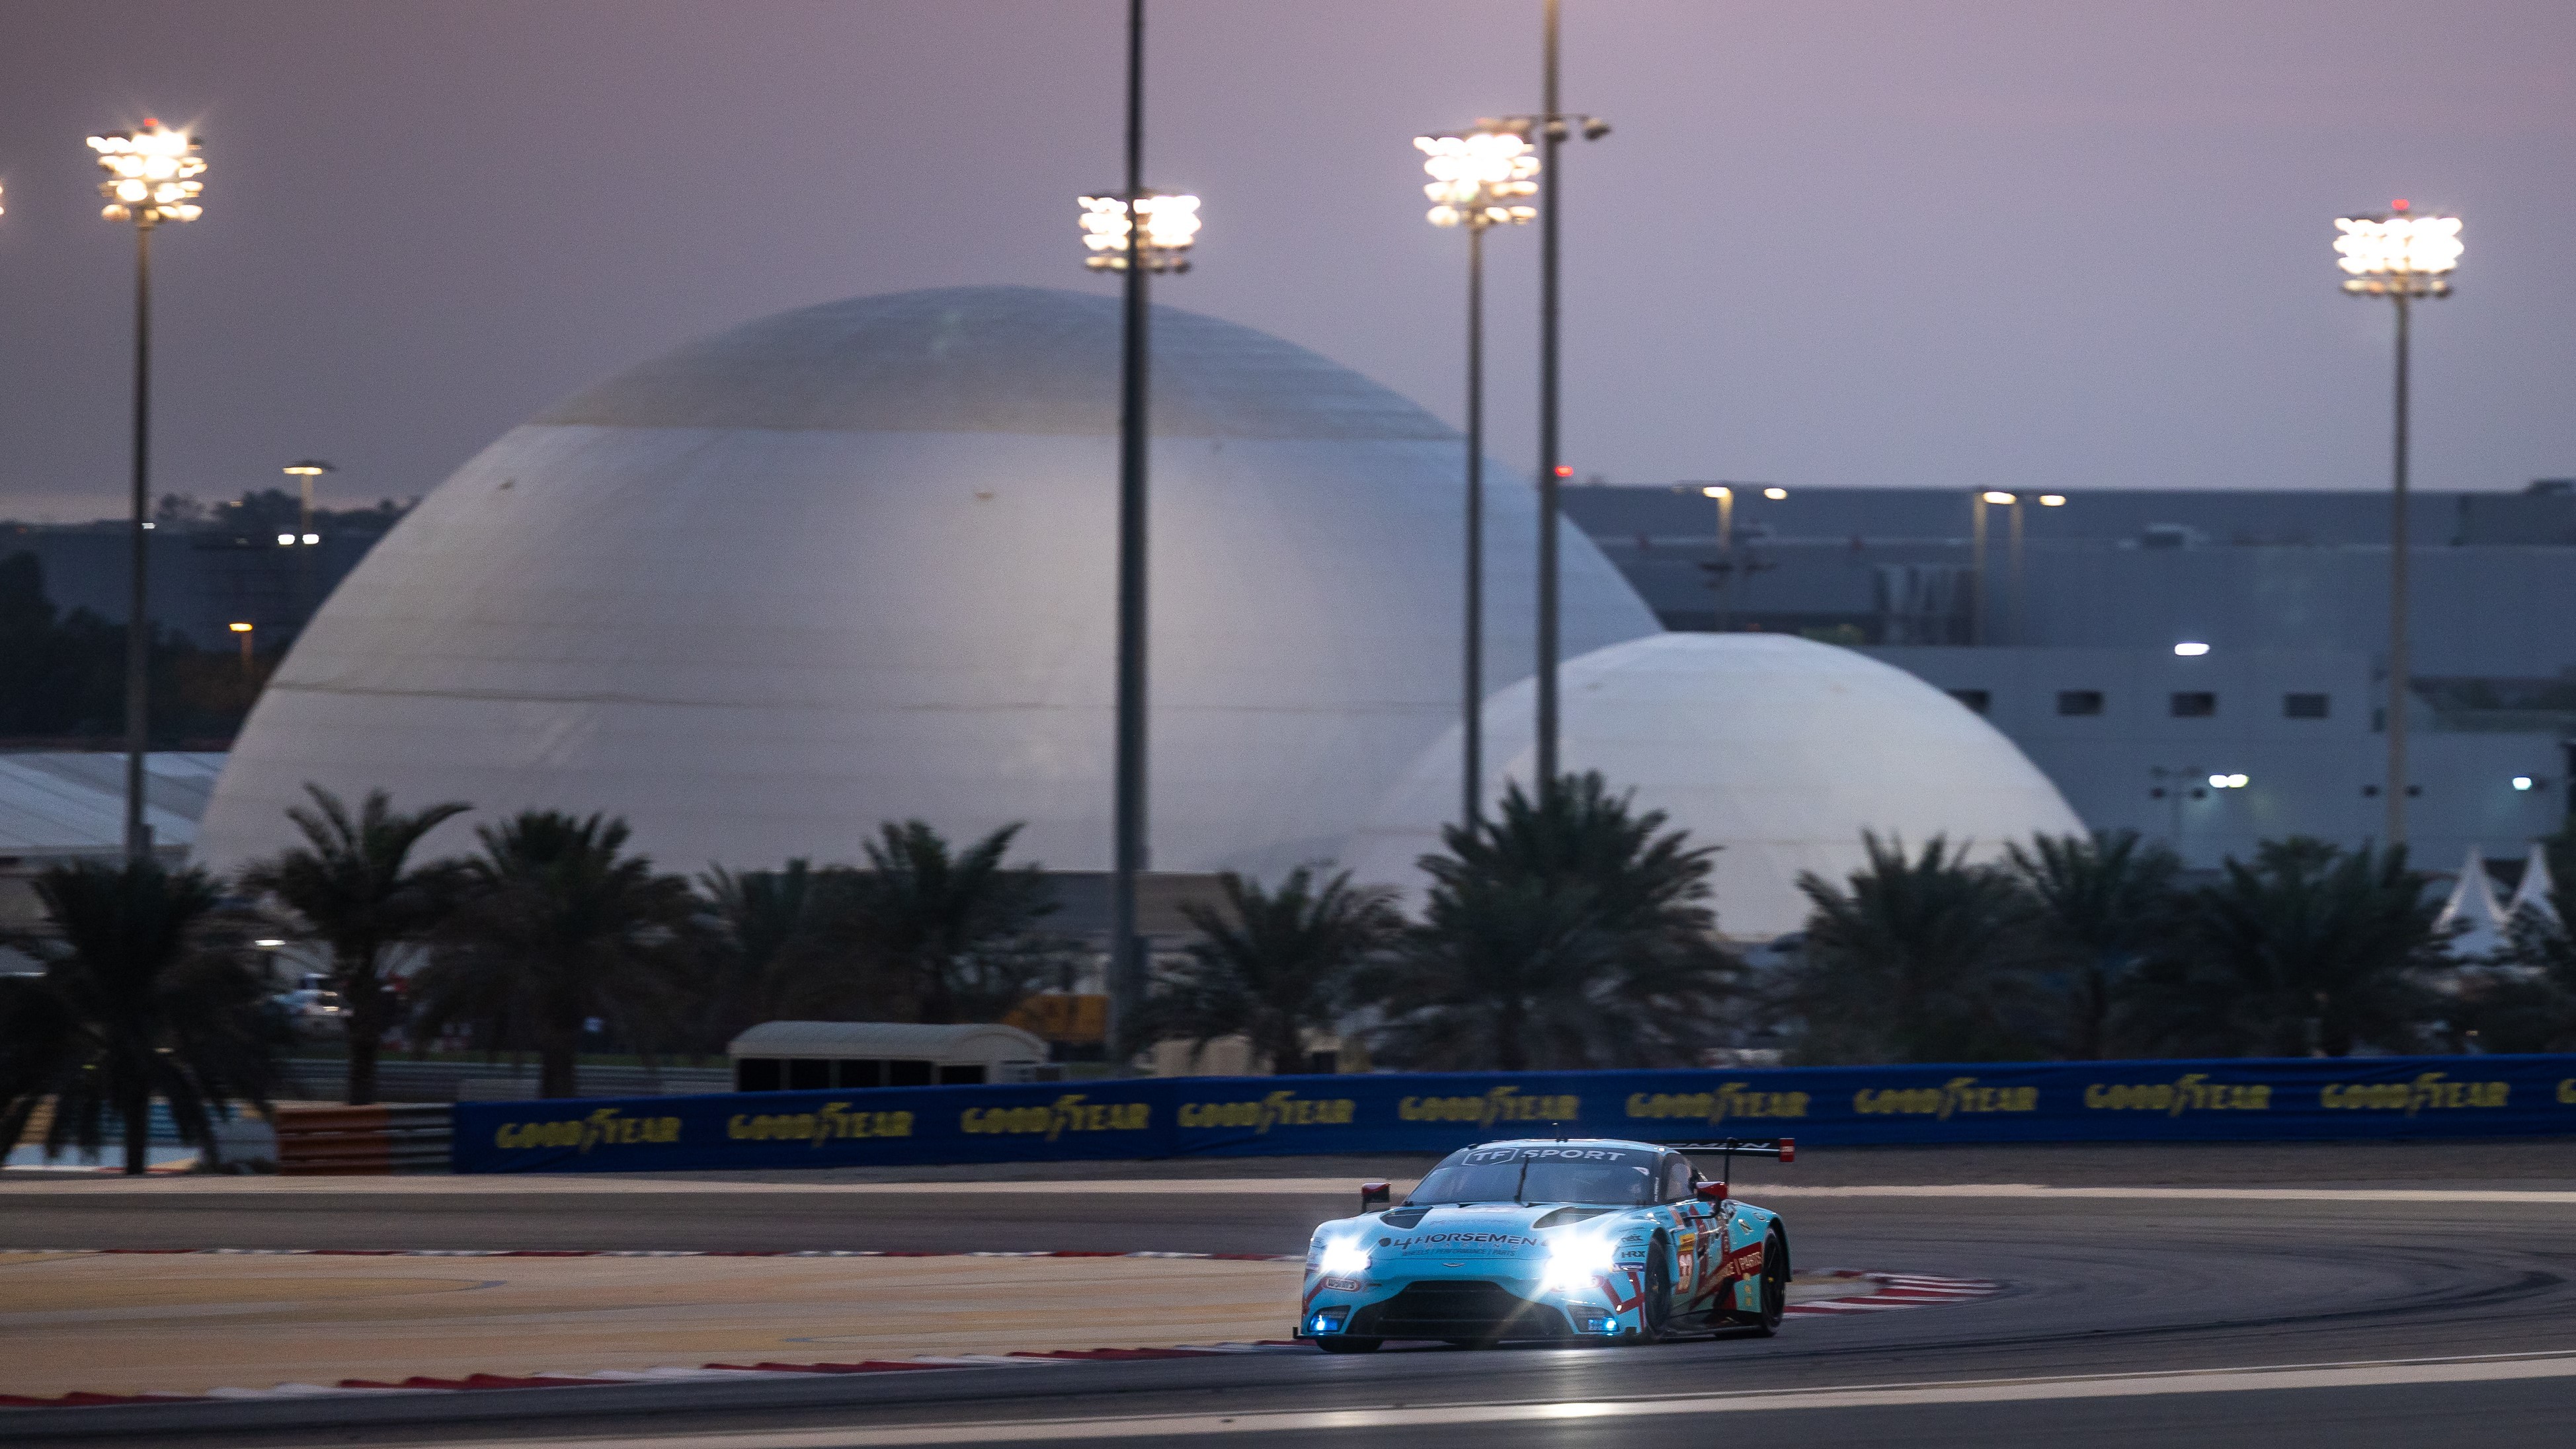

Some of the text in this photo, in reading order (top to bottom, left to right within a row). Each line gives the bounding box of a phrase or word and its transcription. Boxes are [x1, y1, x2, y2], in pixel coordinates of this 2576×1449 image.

[1400, 1087, 1577, 1122] GOODYEAR
[1629, 1082, 1807, 1118] GOODYEAR
[1855, 1077, 2035, 1115] GOODYEAR
[2087, 1074, 2269, 1111] GOODYEAR
[2323, 1072, 2508, 1109] GOODYEAR
[729, 1103, 912, 1141] GOODYEAR
[962, 1095, 1149, 1135] GOODYEAR
[1180, 1091, 1353, 1127] GOODYEAR
[497, 1109, 680, 1150] GOODYEAR
[1473, 1149, 1626, 1161] TF SPORT
[1492, 1249, 1517, 1257] PARTS
[1621, 1250, 1646, 1259] HRX
